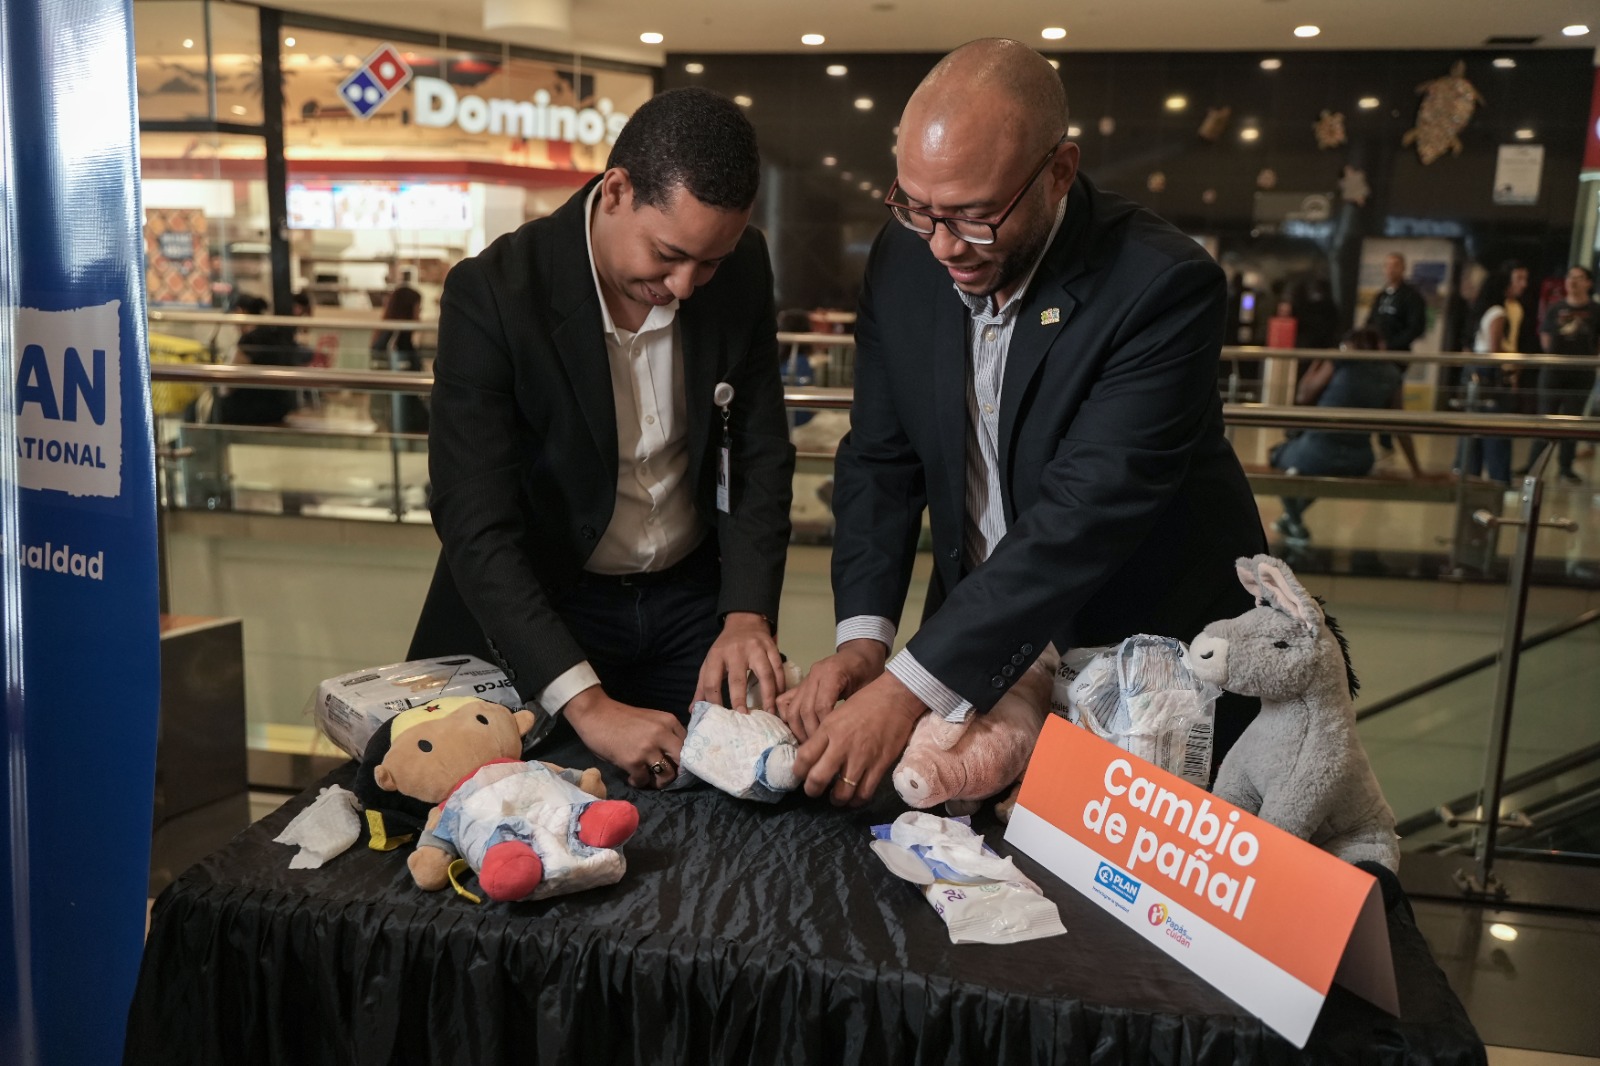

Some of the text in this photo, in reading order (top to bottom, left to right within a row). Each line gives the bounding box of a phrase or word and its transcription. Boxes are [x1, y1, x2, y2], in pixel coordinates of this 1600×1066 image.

[414, 75, 629, 146] Domino's
[1104, 759, 1259, 867] Cambio
[1083, 797, 1256, 920] de pañal
[1113, 874, 1138, 896] PLAN
[1165, 916, 1188, 936] Papás
[1165, 928, 1191, 949] cuidan
